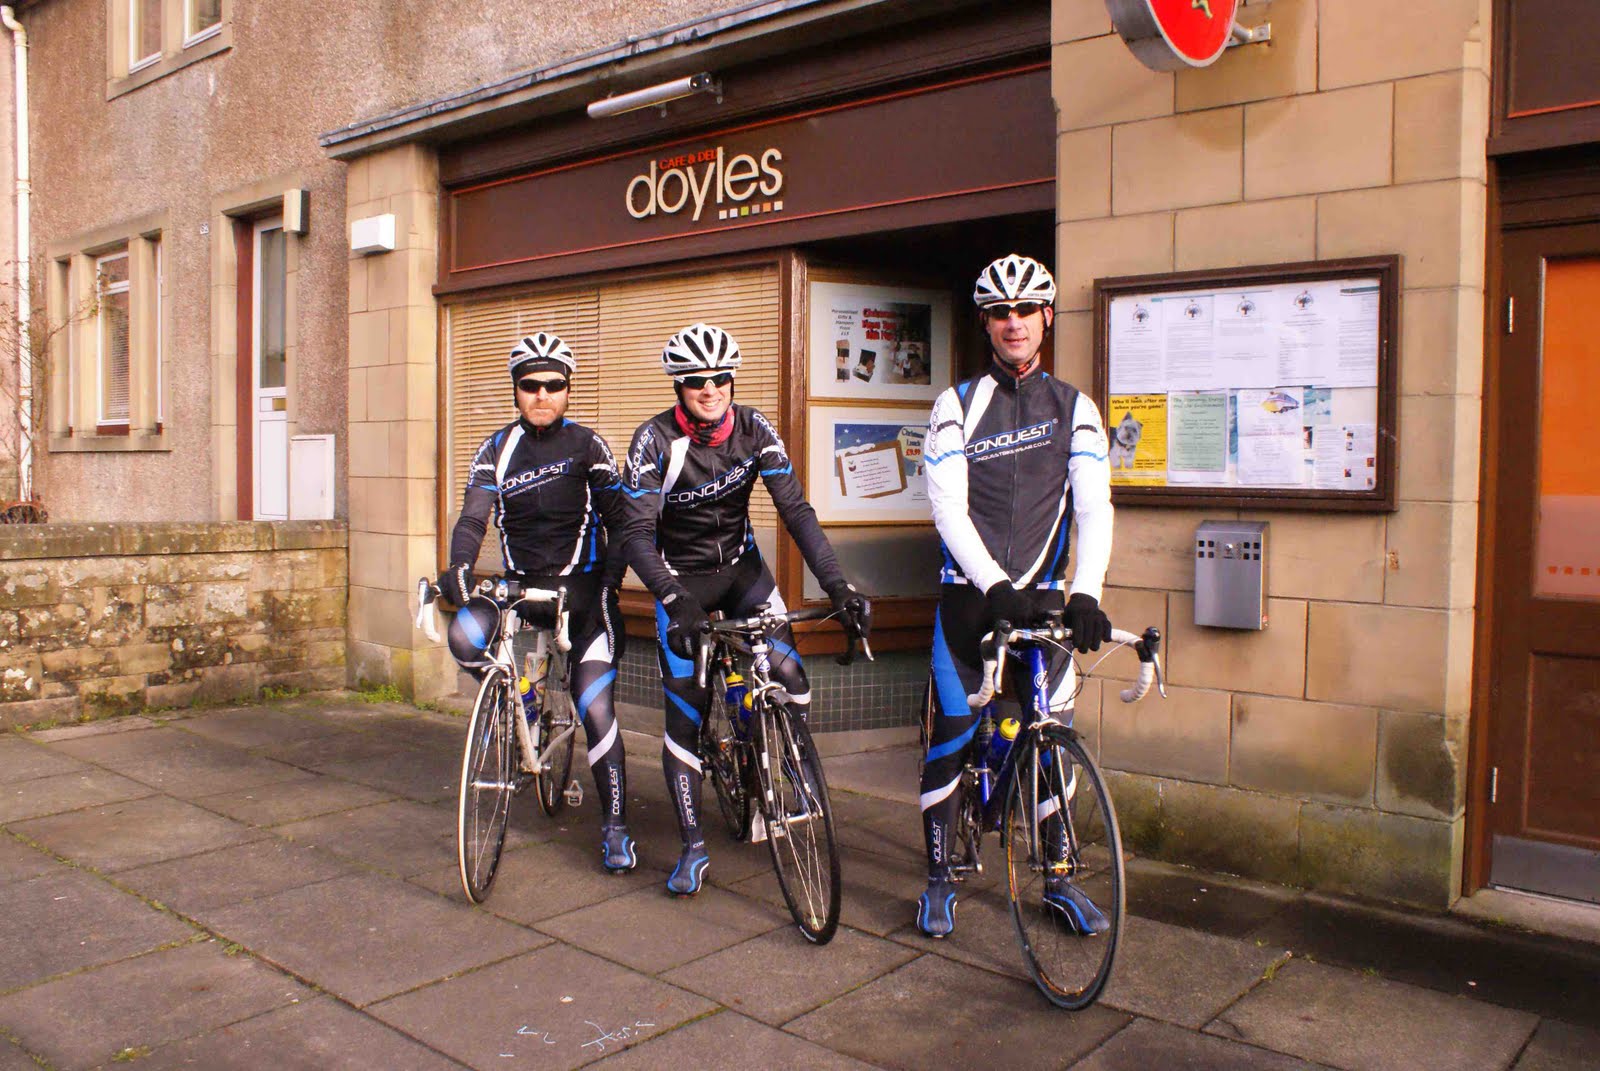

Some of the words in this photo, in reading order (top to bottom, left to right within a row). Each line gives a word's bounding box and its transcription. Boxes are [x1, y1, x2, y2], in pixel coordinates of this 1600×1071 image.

[626, 146, 783, 221] doyles
[658, 156, 686, 170] CAFE
[631, 428, 651, 489] CONQUEST
[965, 423, 1050, 456] CONQUEST
[500, 462, 567, 492] CONQUEST
[667, 460, 754, 503] CONQUEST
[609, 766, 620, 815] CONQUEST
[679, 774, 697, 828] CONQUEST
